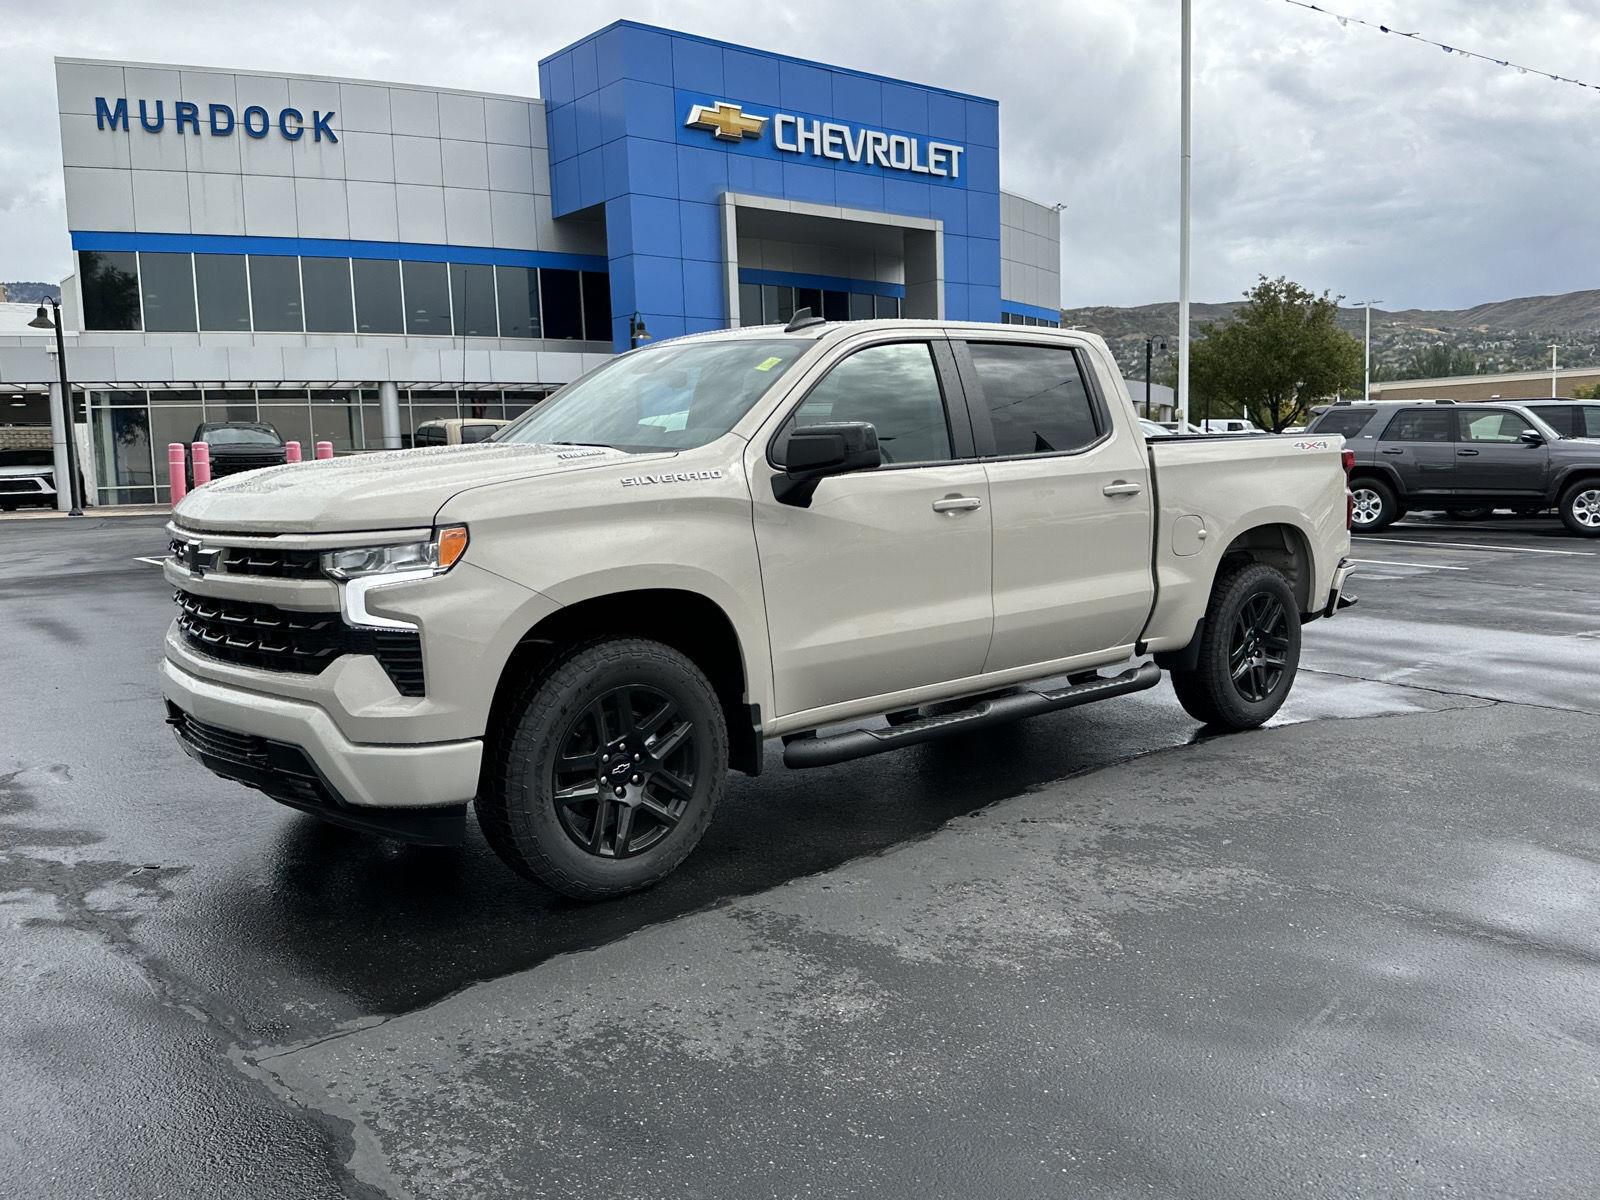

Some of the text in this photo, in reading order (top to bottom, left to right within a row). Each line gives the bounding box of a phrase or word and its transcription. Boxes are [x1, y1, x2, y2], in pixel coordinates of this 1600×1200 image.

[95, 96, 338, 143] MURDOCK
[774, 113, 964, 178] CHEVROLET
[620, 470, 722, 487] SILVERADO
